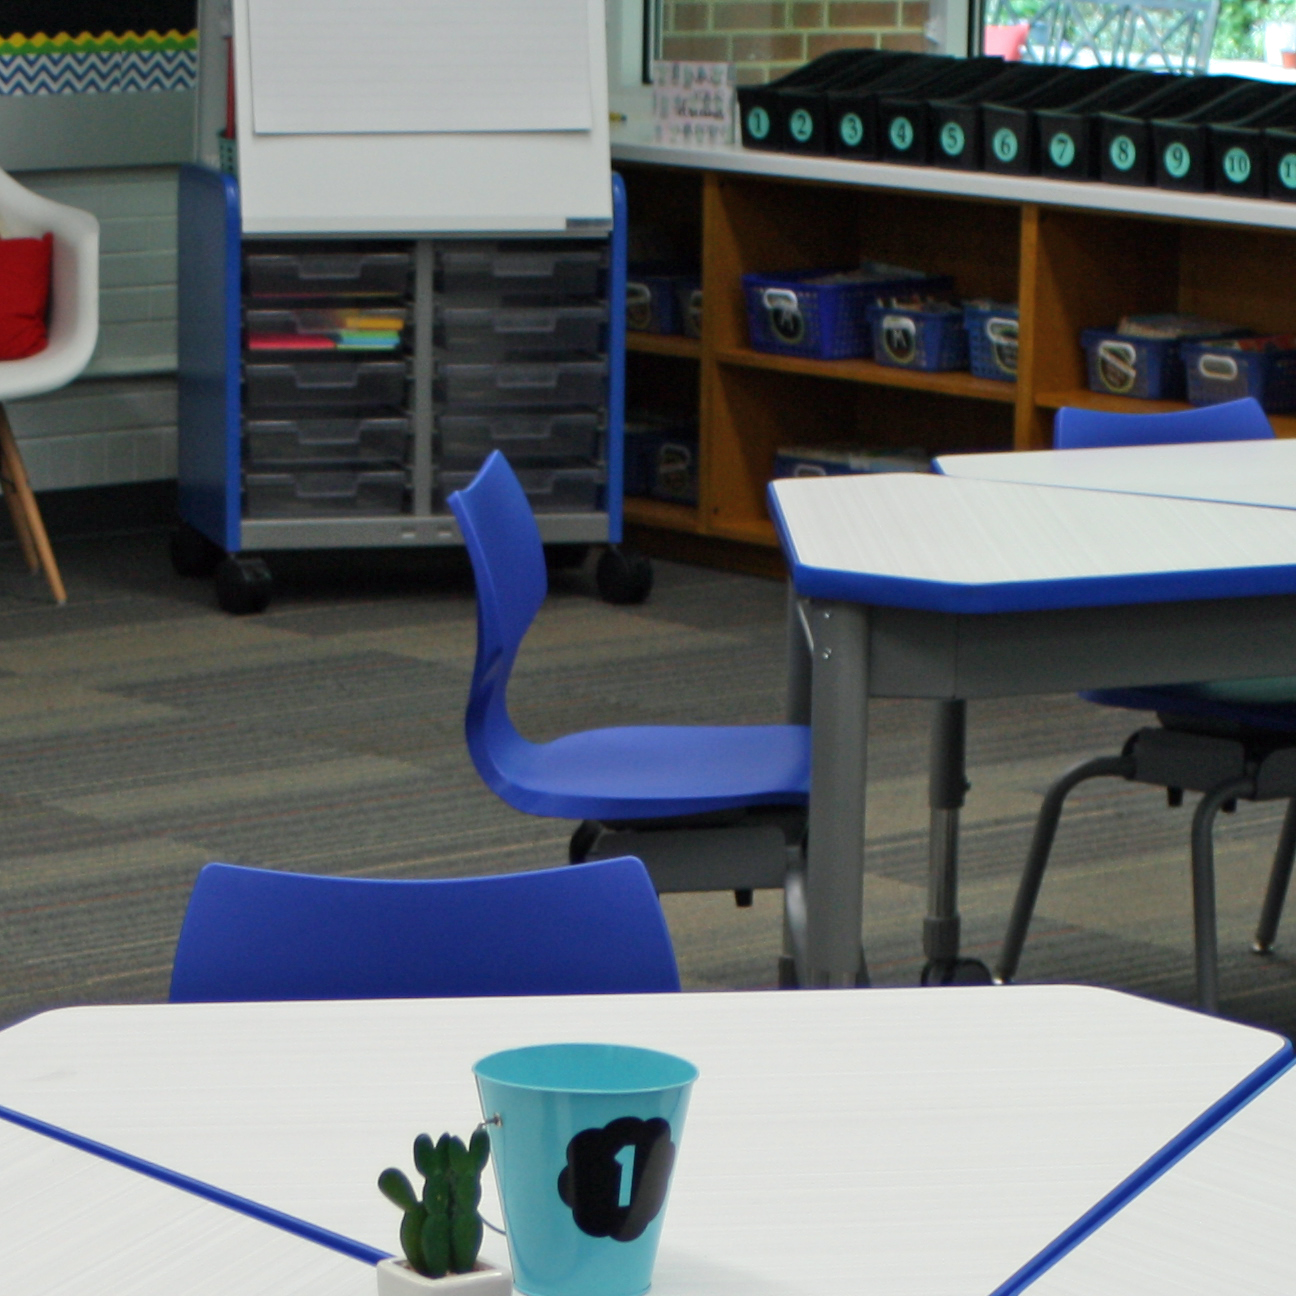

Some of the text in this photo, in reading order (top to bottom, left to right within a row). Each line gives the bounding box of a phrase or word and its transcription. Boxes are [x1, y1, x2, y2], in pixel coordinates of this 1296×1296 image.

[796, 113, 807, 135] 2
[847, 117, 858, 139] 3
[897, 123, 907, 143] 4
[947, 126, 958, 149] 5
[1000, 132, 1011, 155] 6
[1055, 138, 1068, 160] 7
[1117, 140, 1129, 162] 8
[1172, 147, 1184, 170] 9
[1228, 156, 1248, 173] 10
[614, 1143, 636, 1208] 1
